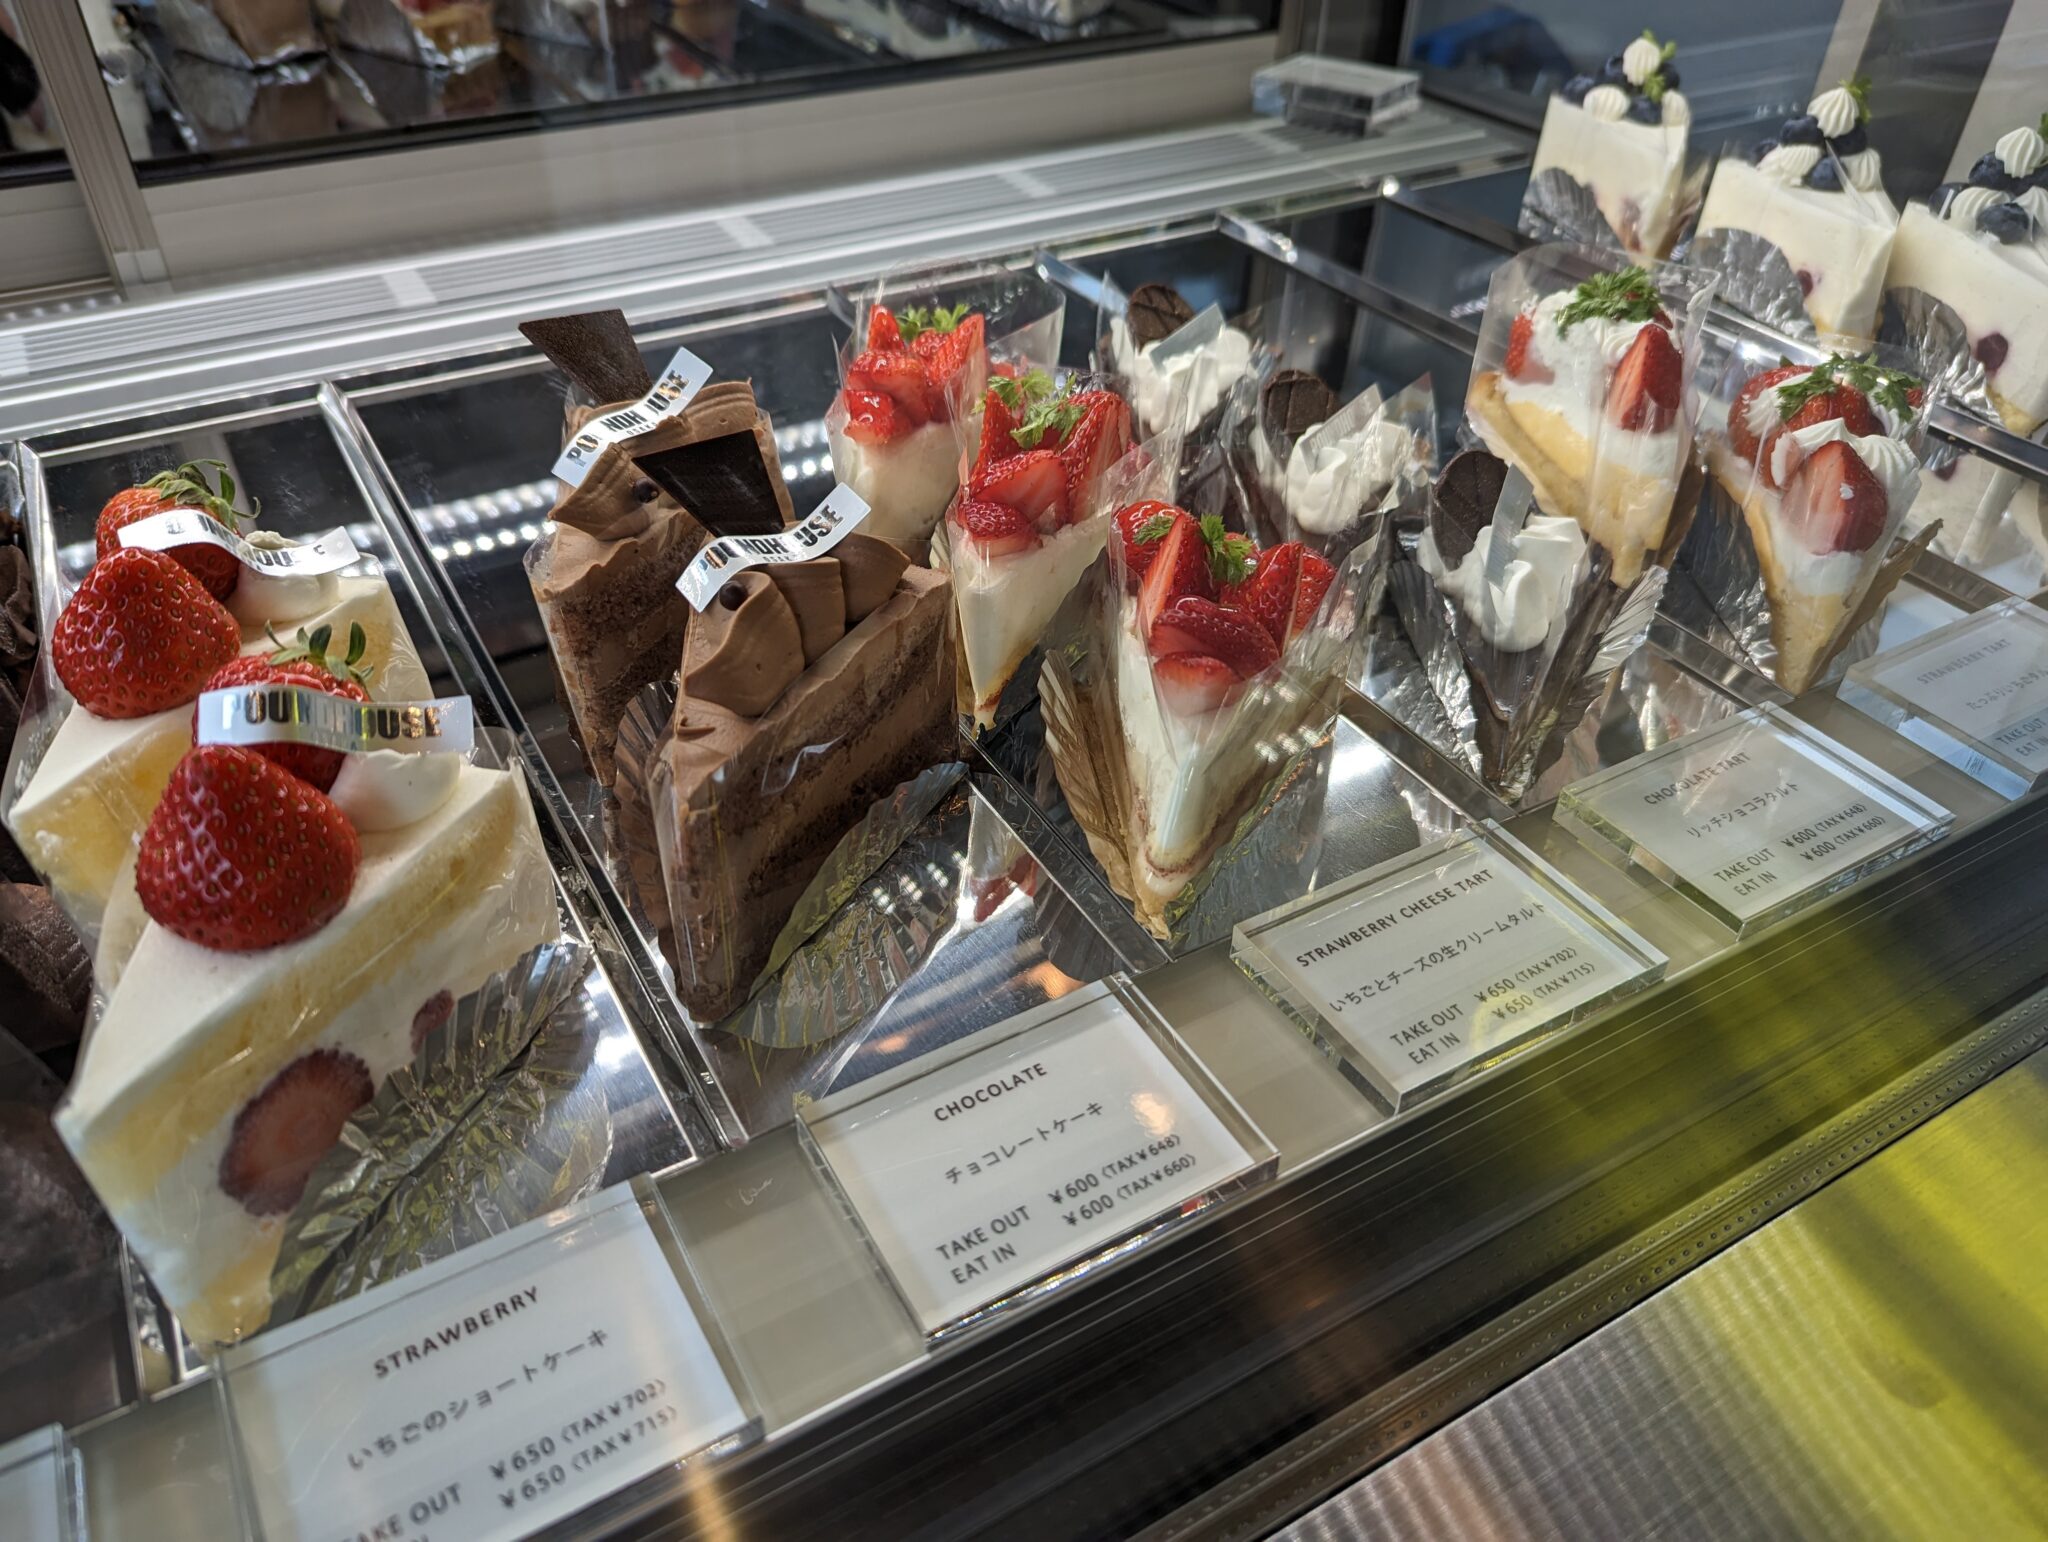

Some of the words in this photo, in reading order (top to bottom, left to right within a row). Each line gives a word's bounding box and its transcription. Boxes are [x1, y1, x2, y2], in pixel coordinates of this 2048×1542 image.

[1717, 752, 1751, 771] TART
[1995, 728, 2028, 745] TAKE
[2023, 717, 2047, 732] OUT
[2016, 742, 2040, 756] EAT
[1713, 863, 1751, 883] TAKE
[1746, 847, 1776, 867] OUT
[1780, 828, 1817, 848] ¥600
[1734, 879, 1760, 896] EAT
[1761, 870, 1778, 886] IN
[1800, 841, 1837, 861] ¥600
[1296, 915, 1398, 968] STRAWBERRY
[1400, 887, 1456, 919] CHEESE
[1455, 868, 1494, 894] TART
[1389, 1021, 1433, 1048] TAKE
[1431, 1003, 1465, 1027] OUT
[1473, 978, 1516, 1003] ¥650
[1408, 1042, 1438, 1065] EAT
[1439, 1032, 1461, 1047] IN
[1491, 994, 1534, 1020] ¥650
[934, 1062, 1048, 1122] CHOCOLATE
[945, 1101, 1104, 1184] チョコレートケーキ
[936, 1227, 990, 1261] TAKE
[990, 1204, 1031, 1235] OUT
[1048, 1172, 1100, 1204] ¥600
[950, 1255, 990, 1285] EAT
[992, 1243, 1018, 1264] IN
[1062, 1194, 1115, 1227] ¥600
[374, 1286, 539, 1380] STRAWBERRY
[347, 1328, 608, 1472] いちごのショートケーキ
[409, 1481, 461, 1526] OUT
[489, 1436, 556, 1481] ¥650
[498, 1463, 567, 1509] ¥650
